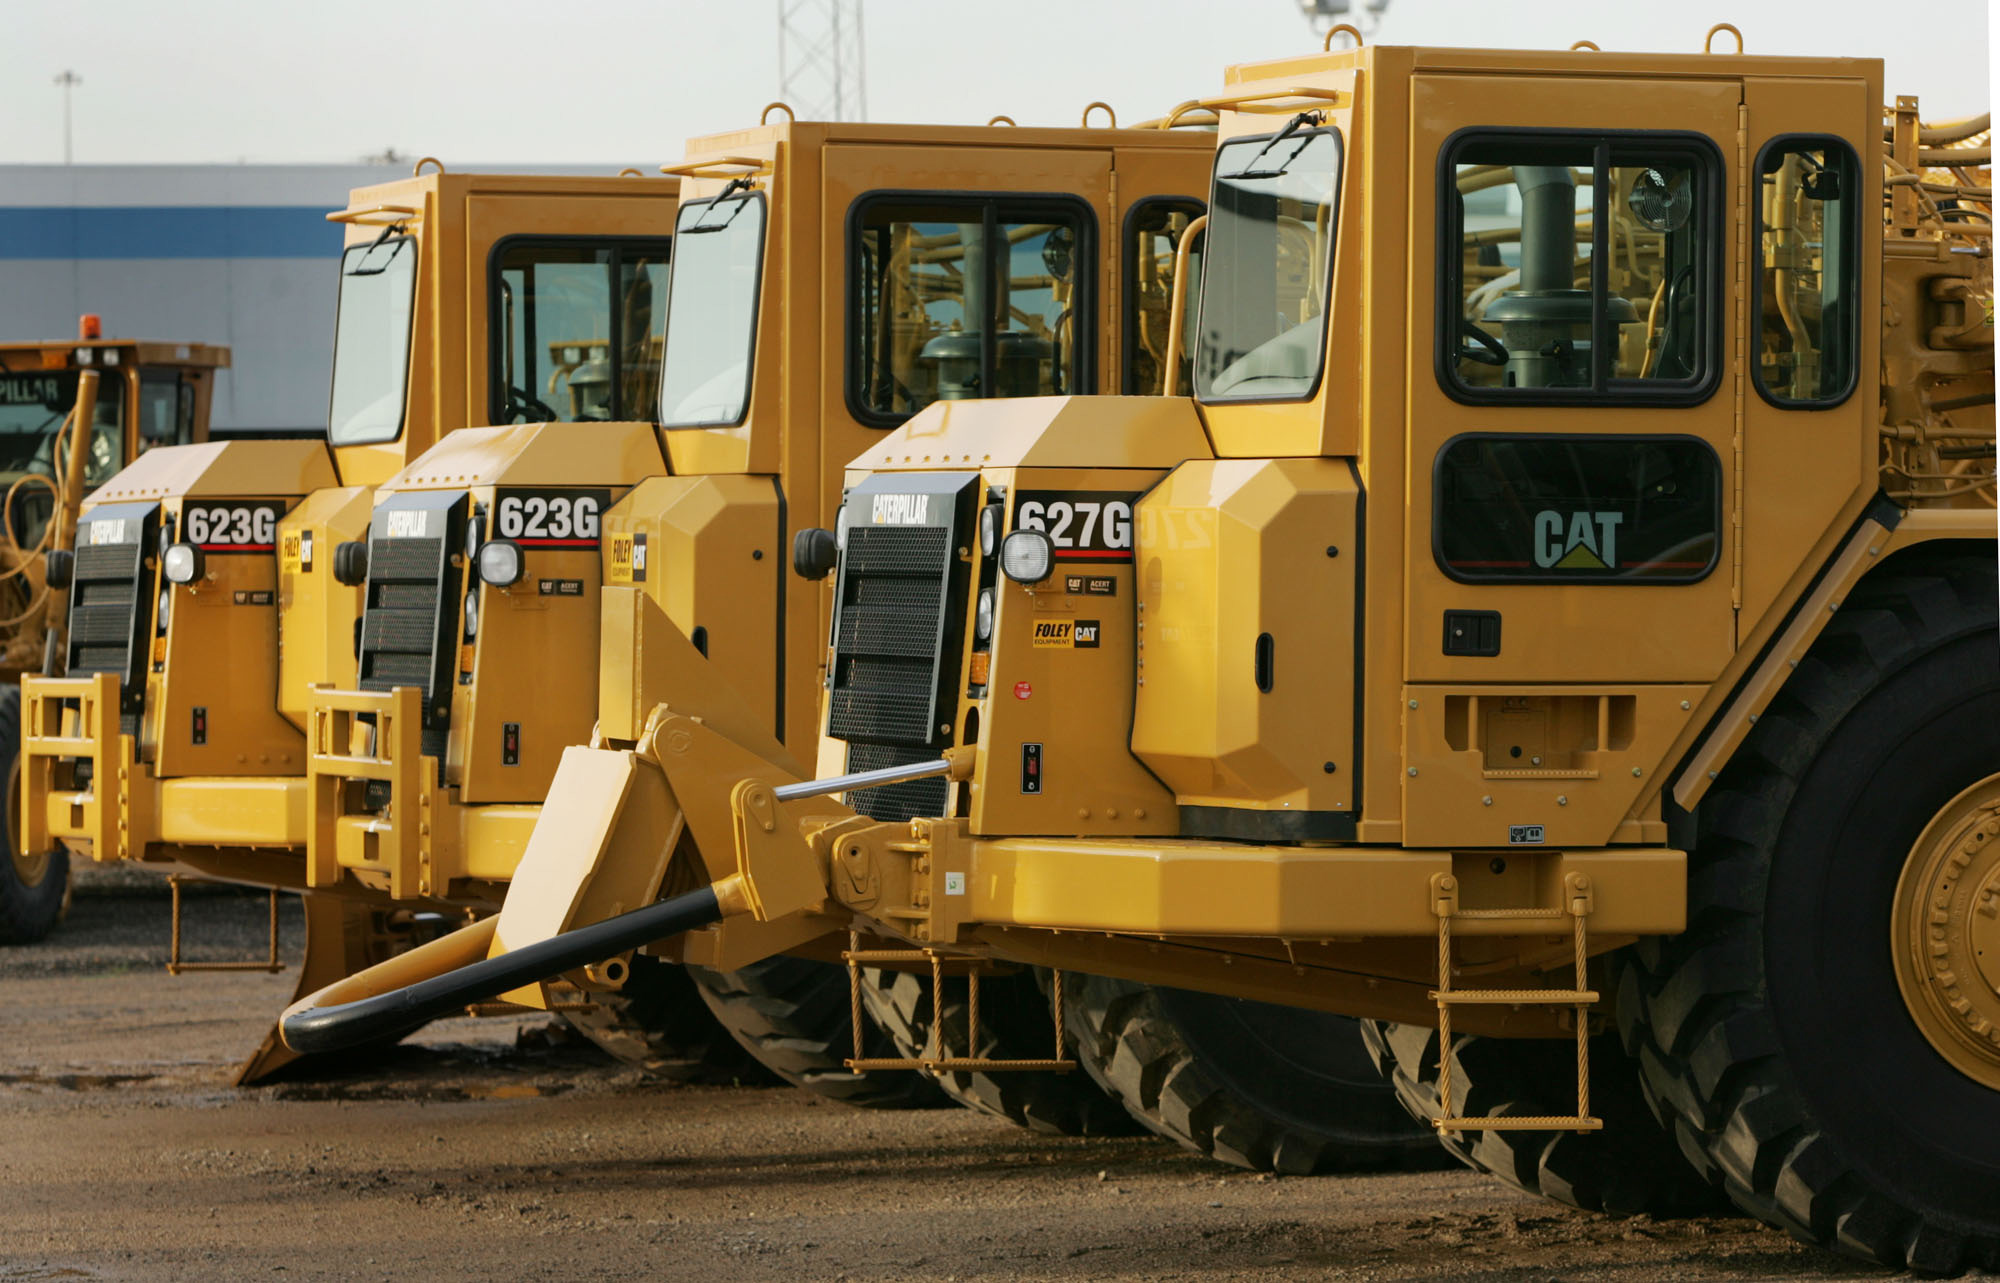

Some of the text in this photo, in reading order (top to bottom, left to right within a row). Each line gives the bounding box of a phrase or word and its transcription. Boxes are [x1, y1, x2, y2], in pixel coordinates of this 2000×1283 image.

[188, 507, 275, 544] 623G
[500, 497, 598, 538] 623G
[872, 494, 929, 525] CATERPILLAR
[1019, 501, 1130, 548] 627G
[613, 540, 646, 569] FOLEY CAT
[1535, 510, 1623, 568] CAT
[1068, 579, 1081, 587] CAT
[1035, 624, 1097, 641] FOLEY CAT
